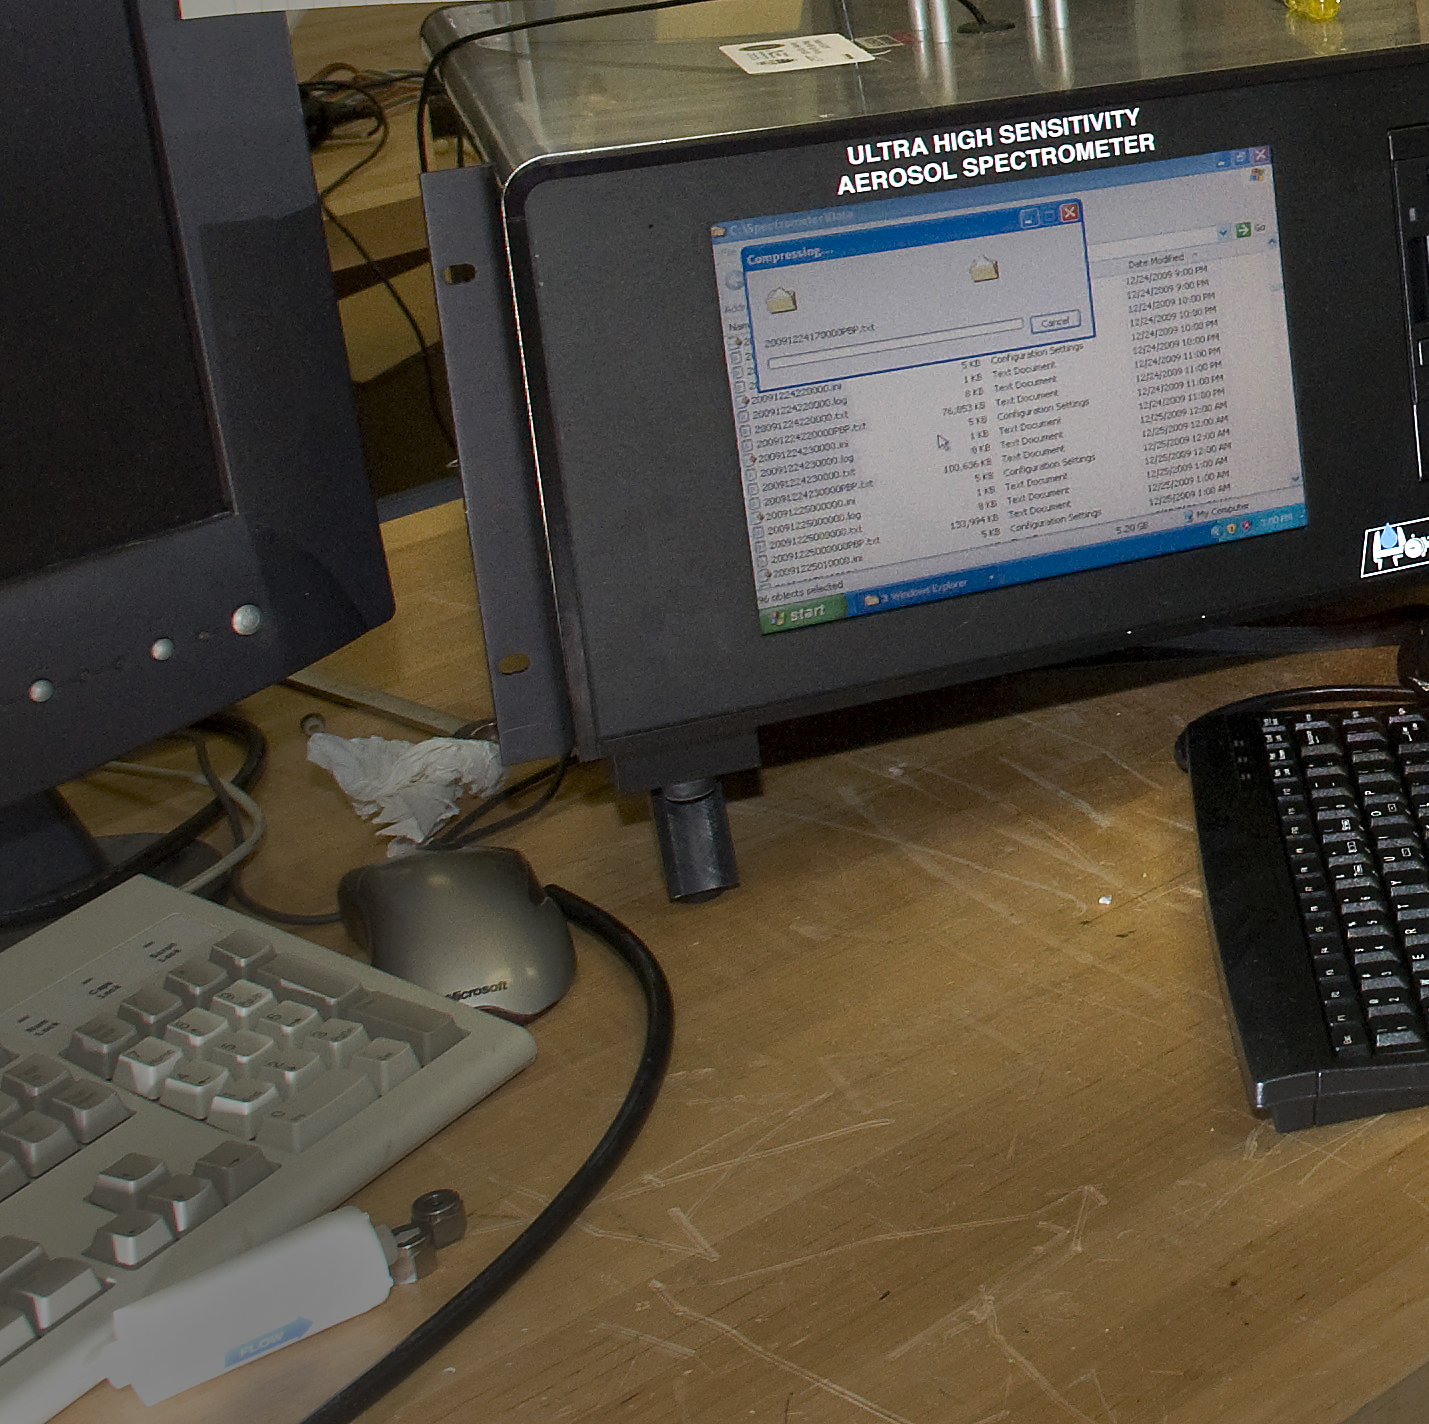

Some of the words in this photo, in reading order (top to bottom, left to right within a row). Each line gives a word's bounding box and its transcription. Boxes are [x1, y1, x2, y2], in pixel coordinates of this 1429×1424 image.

[847, 138, 930, 165] ULTRA
[933, 127, 994, 154] HIGH
[999, 107, 1141, 144] SENSITIVITY
[837, 161, 958, 196] AEROSOL
[962, 133, 1156, 178] SPECTROMETER
[1041, 317, 1070, 328] Cancel
[790, 604, 826, 622] start
[240, 1331, 285, 1356] FLOW
